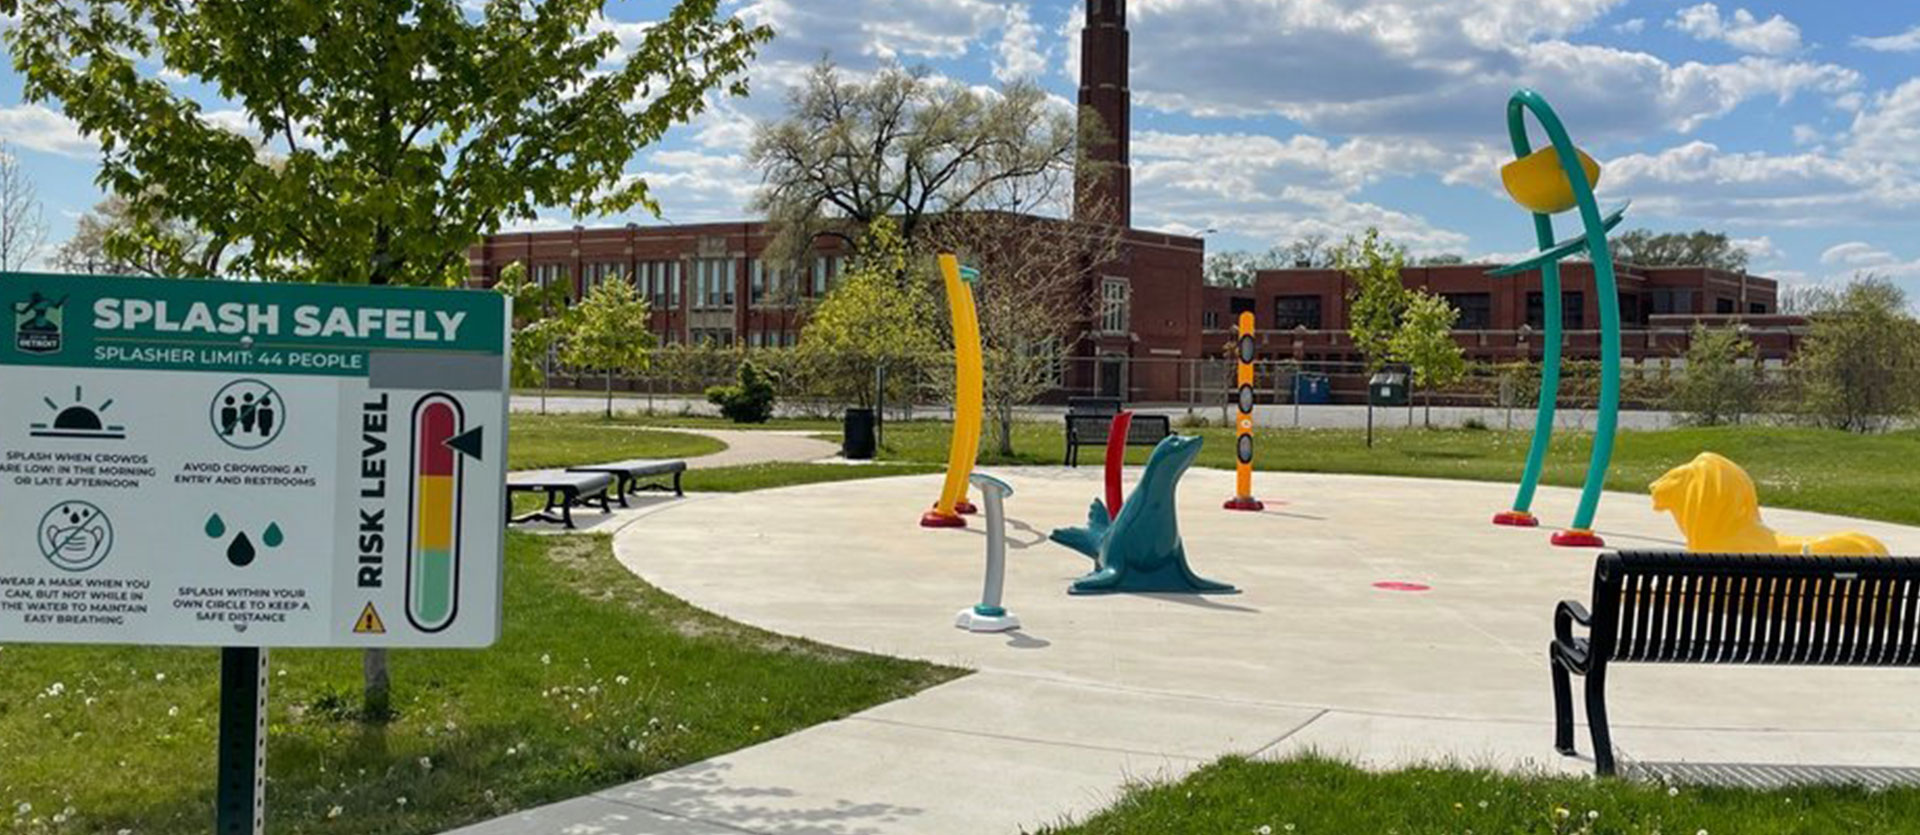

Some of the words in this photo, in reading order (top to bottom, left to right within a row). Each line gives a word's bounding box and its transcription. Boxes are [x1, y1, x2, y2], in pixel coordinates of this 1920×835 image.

[93, 297, 280, 335] SPLASH
[293, 304, 467, 342] SAFELY
[94, 345, 195, 363] SPLASHER
[201, 350, 253, 366] LIMIT:
[257, 352, 283, 366] 44
[288, 352, 362, 369] PEOPLE
[360, 392, 388, 498] LEVEL
[6, 451, 52, 462] SPLASH
[54, 452, 92, 463] WHEN
[95, 453, 148, 465] CROWDS
[0, 463, 21, 473] ARE
[58, 465, 70, 474] IN
[73, 465, 96, 475] THE
[99, 466, 156, 477] MORNING
[183, 462, 221, 473] AVOID
[223, 463, 290, 474] CROWDING
[293, 465, 308, 475] AT
[14, 476, 32, 485] OR
[34, 477, 62, 486] LATE
[66, 477, 139, 488] AFTERNOON
[174, 474, 212, 484] ENTRY
[215, 475, 241, 485] AND
[244, 476, 316, 487] RESTROOMS
[357, 508, 385, 588] RISK
[0, 577, 35, 586] WEAR
[37, 578, 46, 586] A
[49, 578, 82, 588] MASK
[86, 579, 122, 588] WHEN
[125, 579, 150, 589] YOU
[36, 589, 60, 599] BUT
[62, 590, 87, 600] NOT
[90, 590, 128, 600] WHILE
[130, 591, 143, 600] IN
[178, 587, 223, 597] SPLASH
[226, 588, 270, 598] WITHIN
[272, 588, 306, 598] YOUR
[1, 601, 23, 610] THE
[27, 602, 68, 611] WATER
[71, 602, 87, 612] TO
[90, 603, 148, 613] MAINTAIN
[172, 599, 203, 609] OWN
[205, 599, 246, 610] CIRCLE
[250, 600, 266, 610] TO
[268, 601, 299, 610] KEEP
[301, 601, 311, 611] A
[24, 614, 54, 623] EASY
[56, 614, 124, 625] BREATHING
[196, 611, 225, 622] SAFE
[228, 612, 286, 622] DISTANCE
